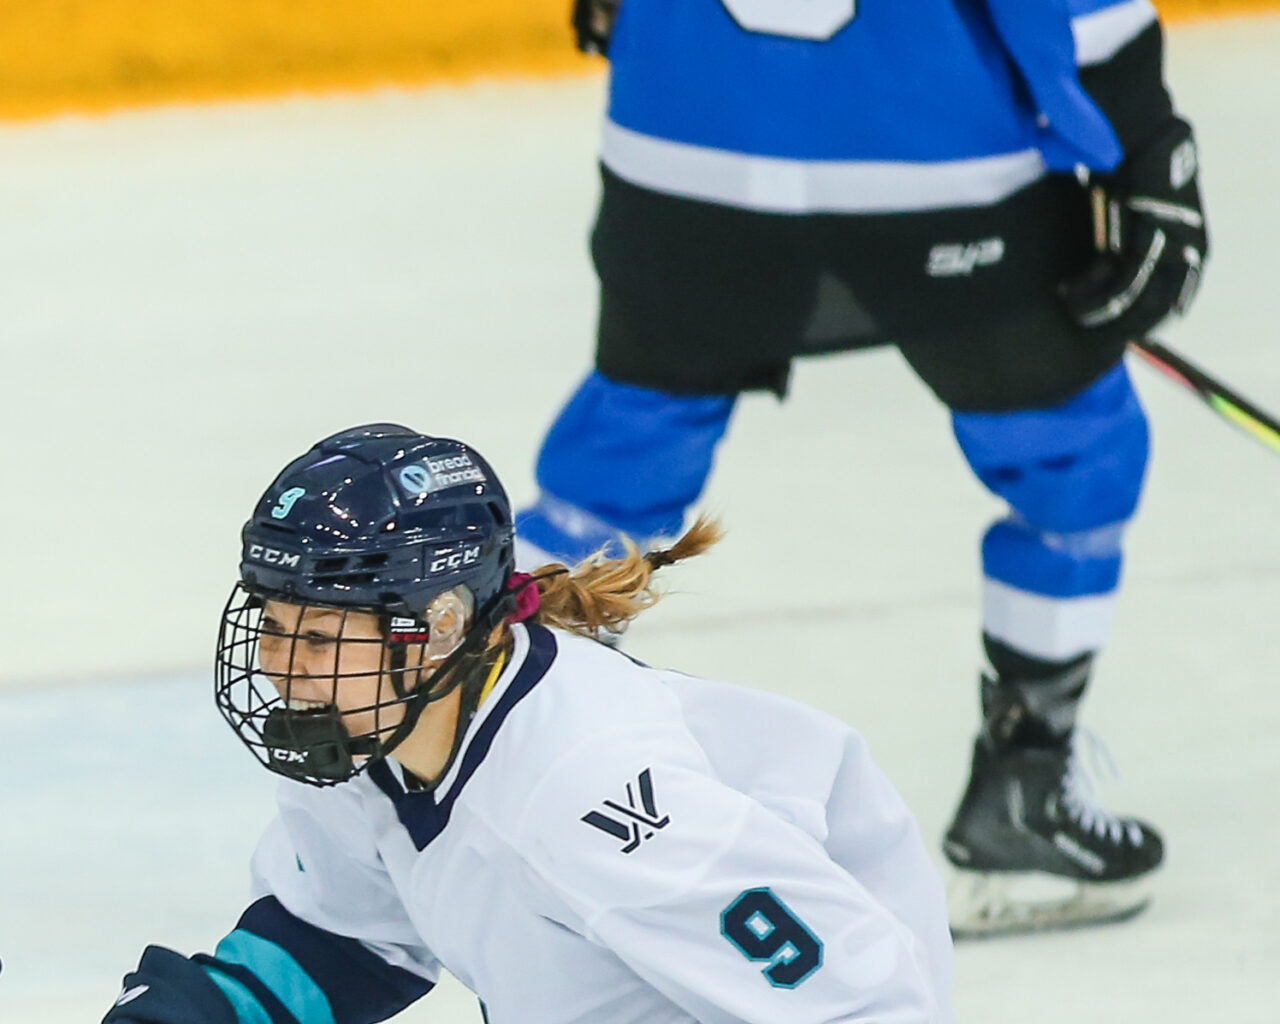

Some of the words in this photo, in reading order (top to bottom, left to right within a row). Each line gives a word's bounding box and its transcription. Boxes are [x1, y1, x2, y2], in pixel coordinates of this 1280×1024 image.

[426, 453, 472, 474] bread
[271, 486, 306, 520] 9
[249, 543, 301, 568] CCM
[429, 546, 480, 573] CCM
[269, 747, 309, 763] CM
[719, 886, 824, 990] 9
